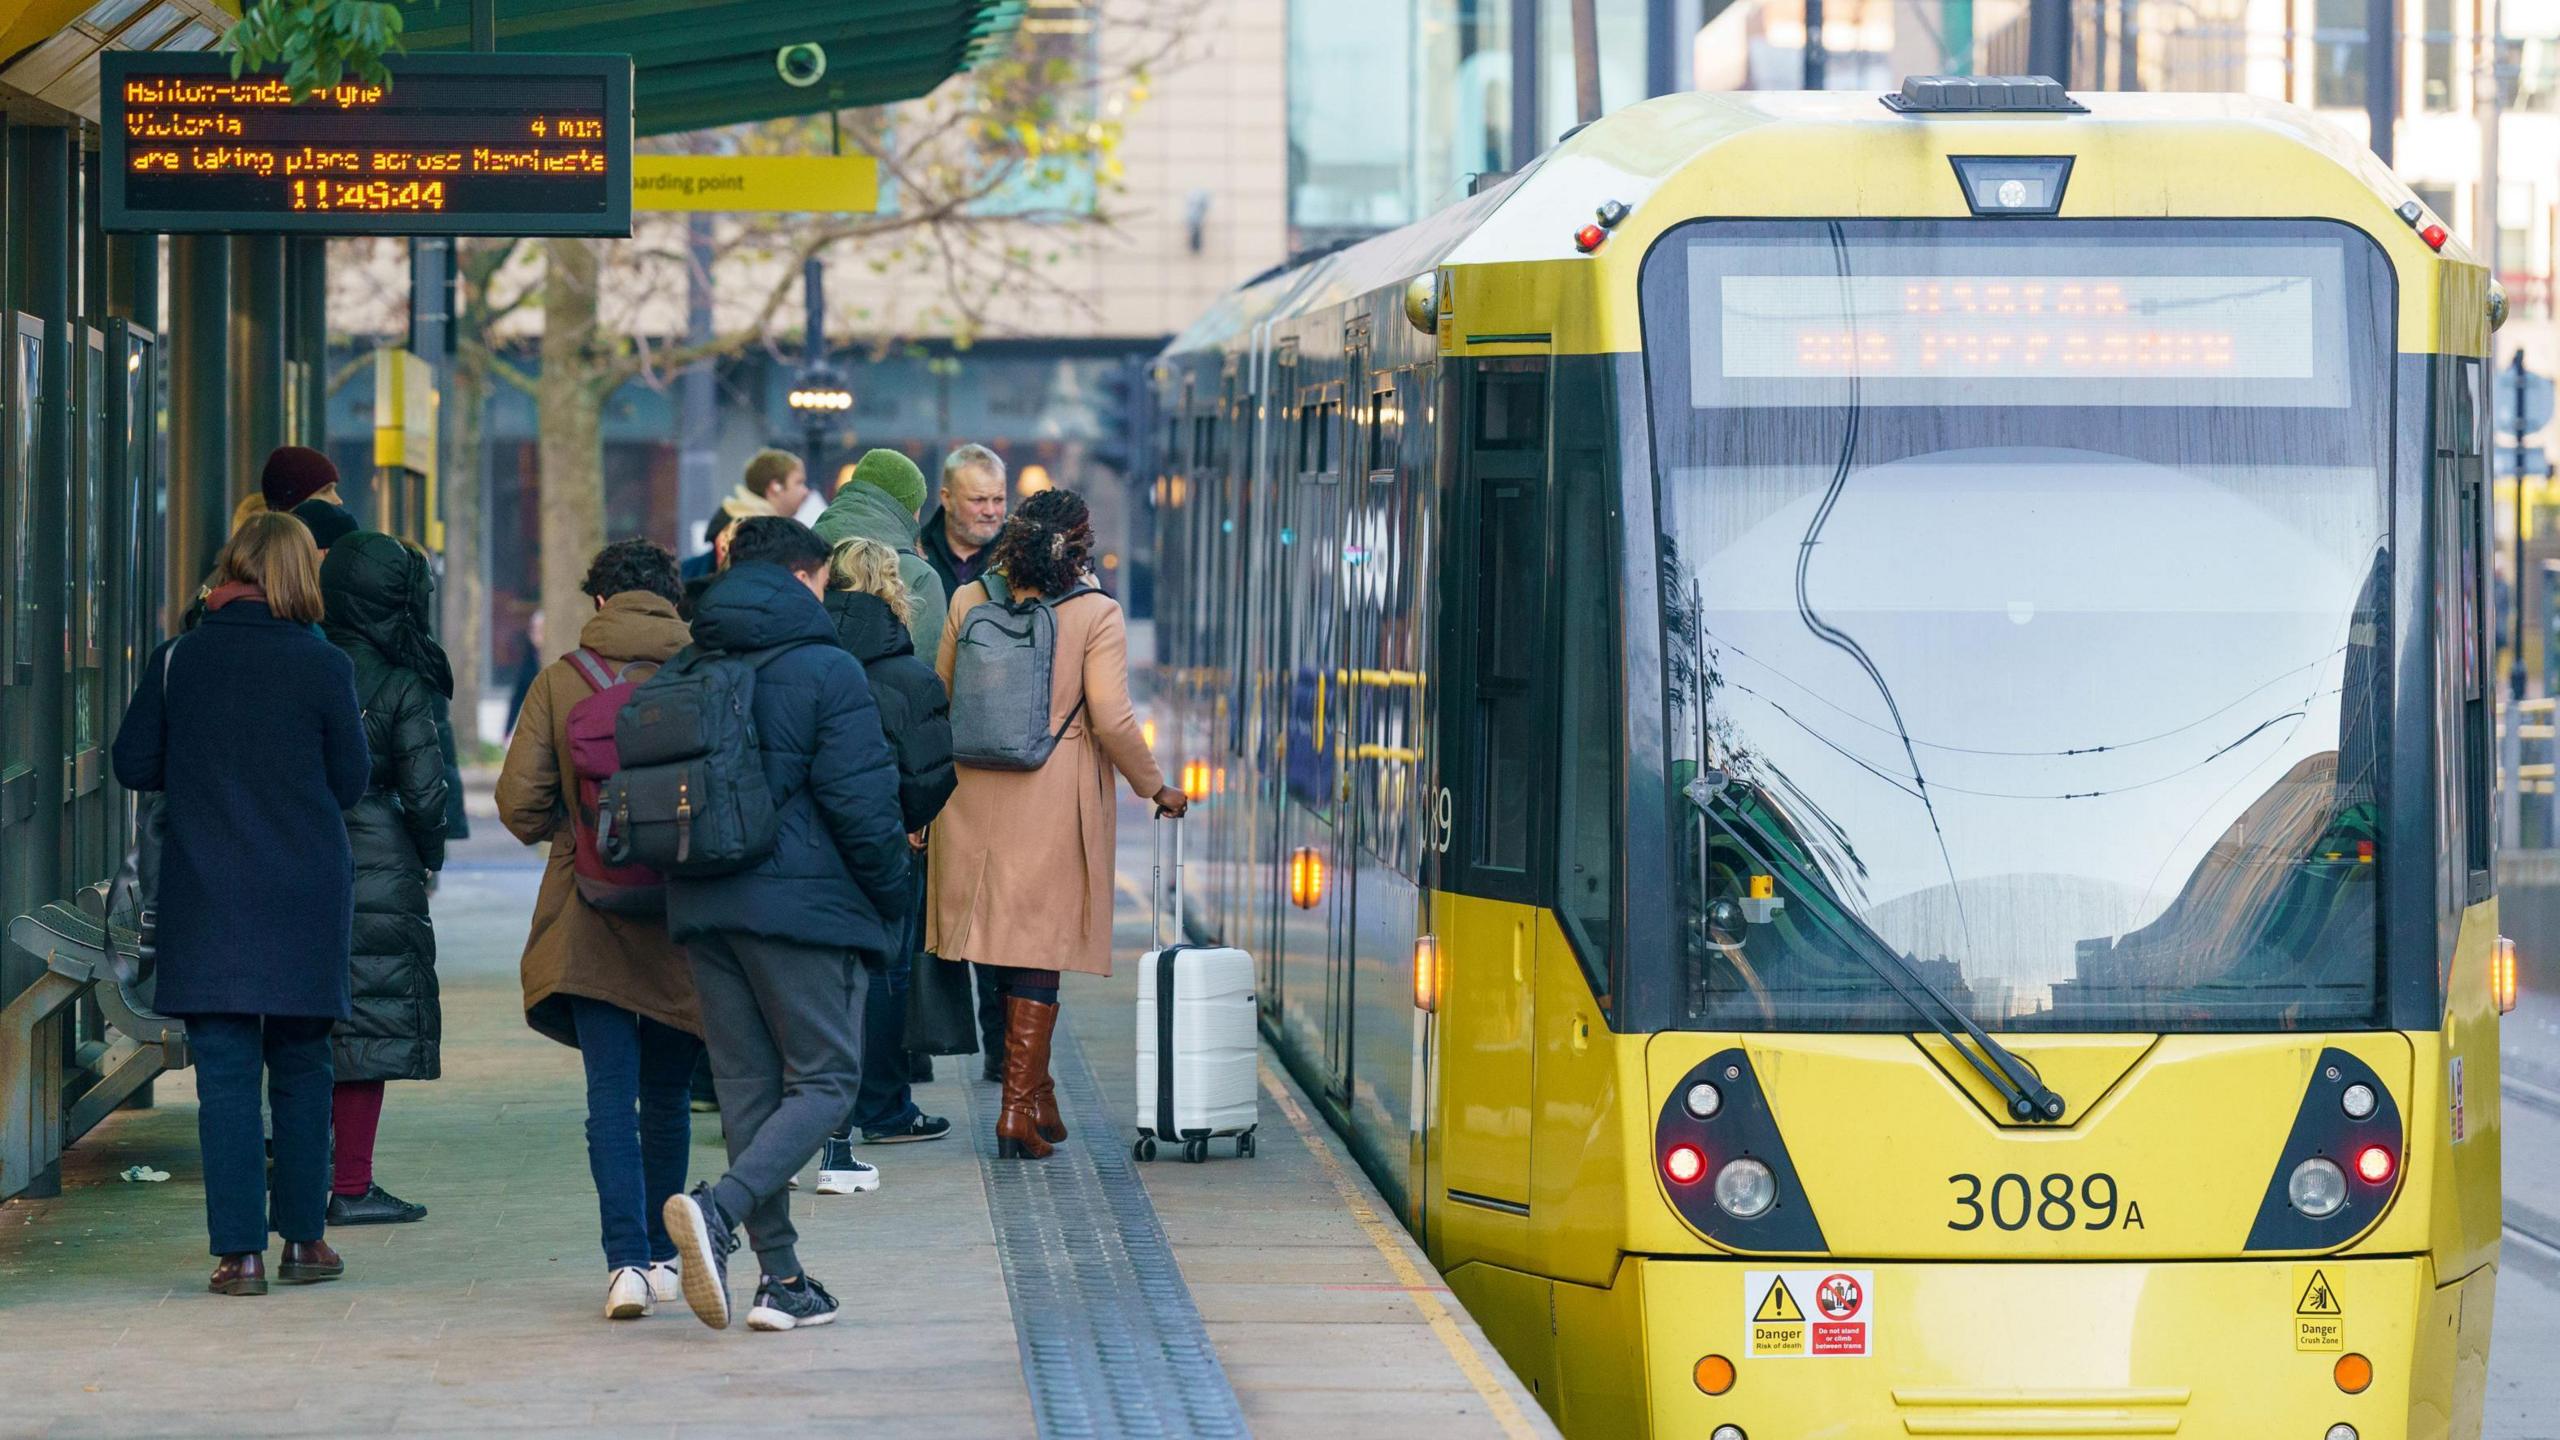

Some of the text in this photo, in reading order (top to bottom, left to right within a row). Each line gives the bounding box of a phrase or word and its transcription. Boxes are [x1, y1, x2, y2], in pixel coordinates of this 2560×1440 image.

[128, 113, 603, 138] Victoria 4 min
[133, 152, 180, 170] are
[632, 172, 744, 196] arding point
[1756, 1328, 1803, 1342] Danger
[2302, 1323, 2337, 1337] Danger
[2300, 1336, 2339, 1344] Crush Zone
